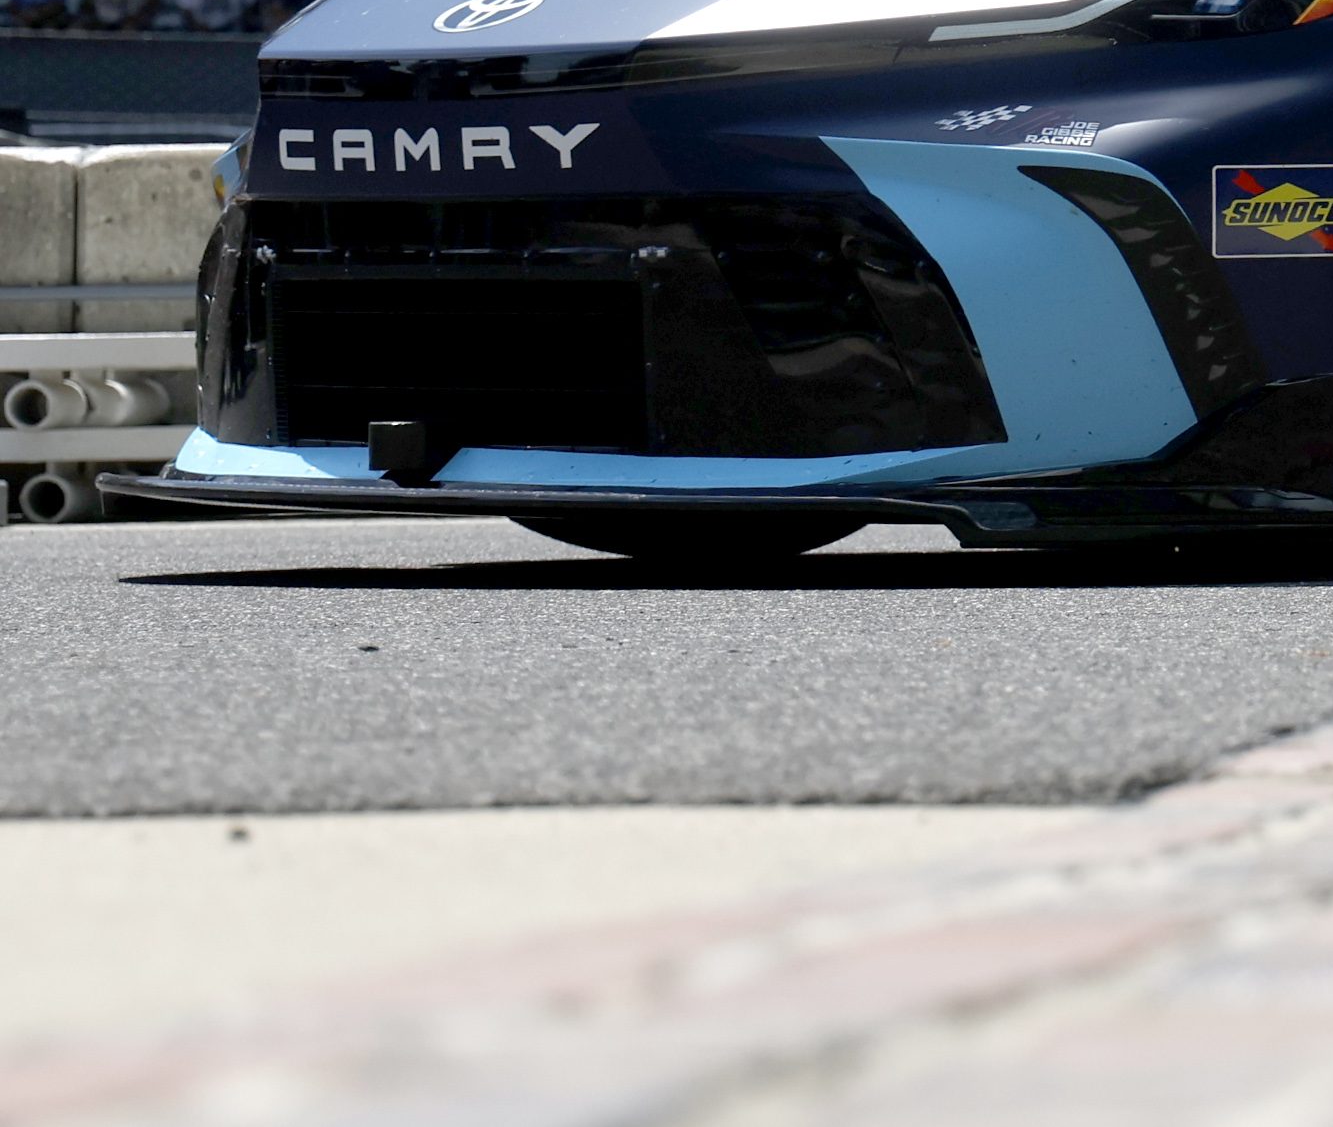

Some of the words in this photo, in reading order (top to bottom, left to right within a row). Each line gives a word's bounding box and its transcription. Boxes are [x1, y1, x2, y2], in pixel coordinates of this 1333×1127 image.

[1060, 121, 1101, 129] JOE
[1041, 127, 1097, 137] GIBBS
[1025, 135, 1094, 147] RACING
[278, 123, 601, 172] CAMRY
